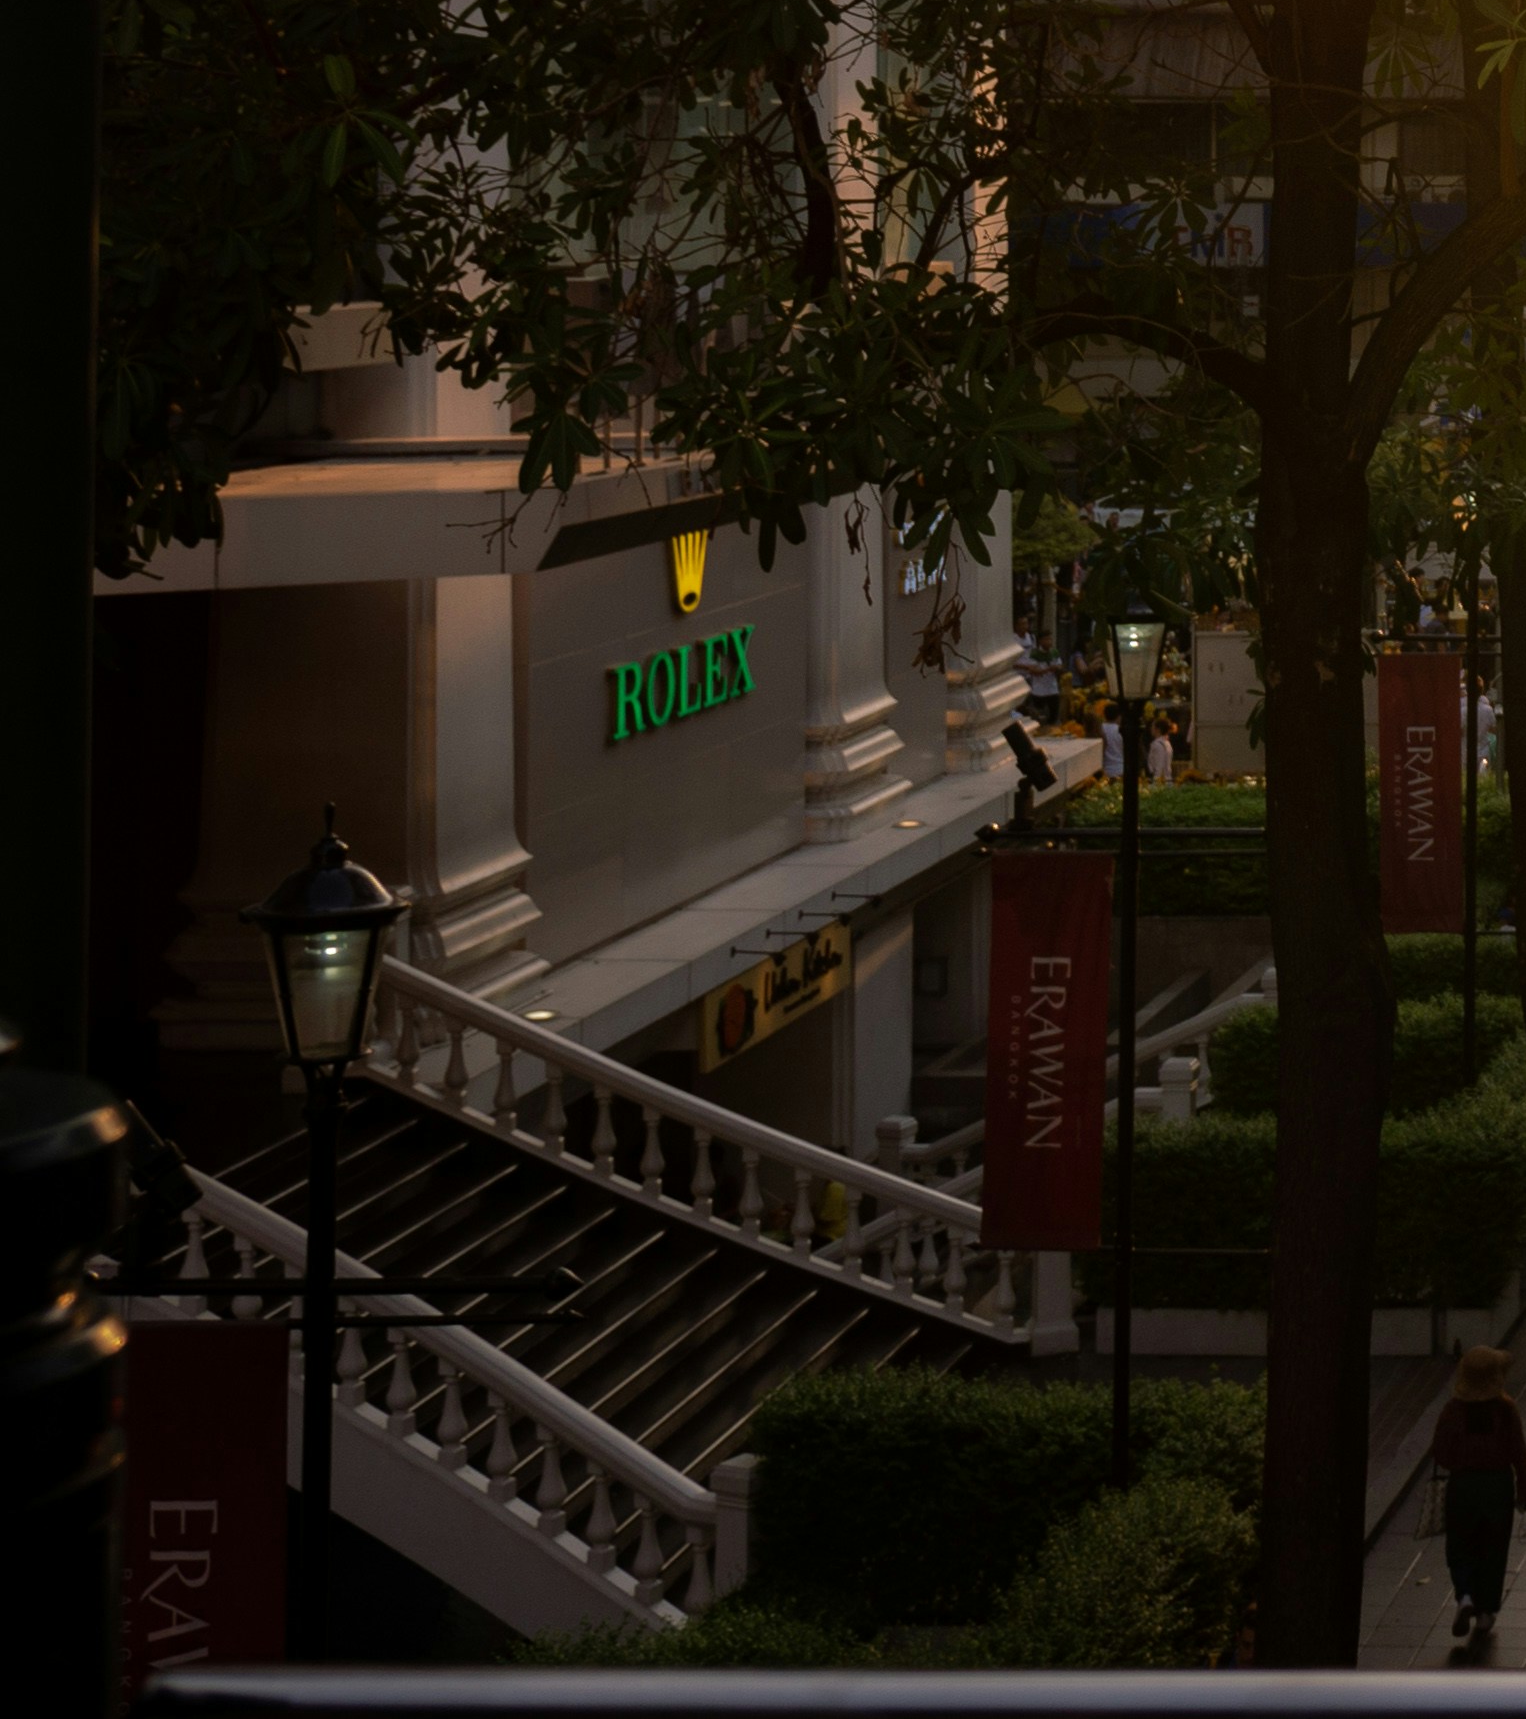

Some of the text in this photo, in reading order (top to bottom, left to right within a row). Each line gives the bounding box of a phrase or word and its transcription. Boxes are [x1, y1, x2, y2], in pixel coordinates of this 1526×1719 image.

[610, 624, 756, 742] ROLEX
[1403, 726, 1436, 861] ERAWAN
[1007, 994, 1022, 1101] BANGKOK
[1024, 956, 1072, 1149] ERAWAN
